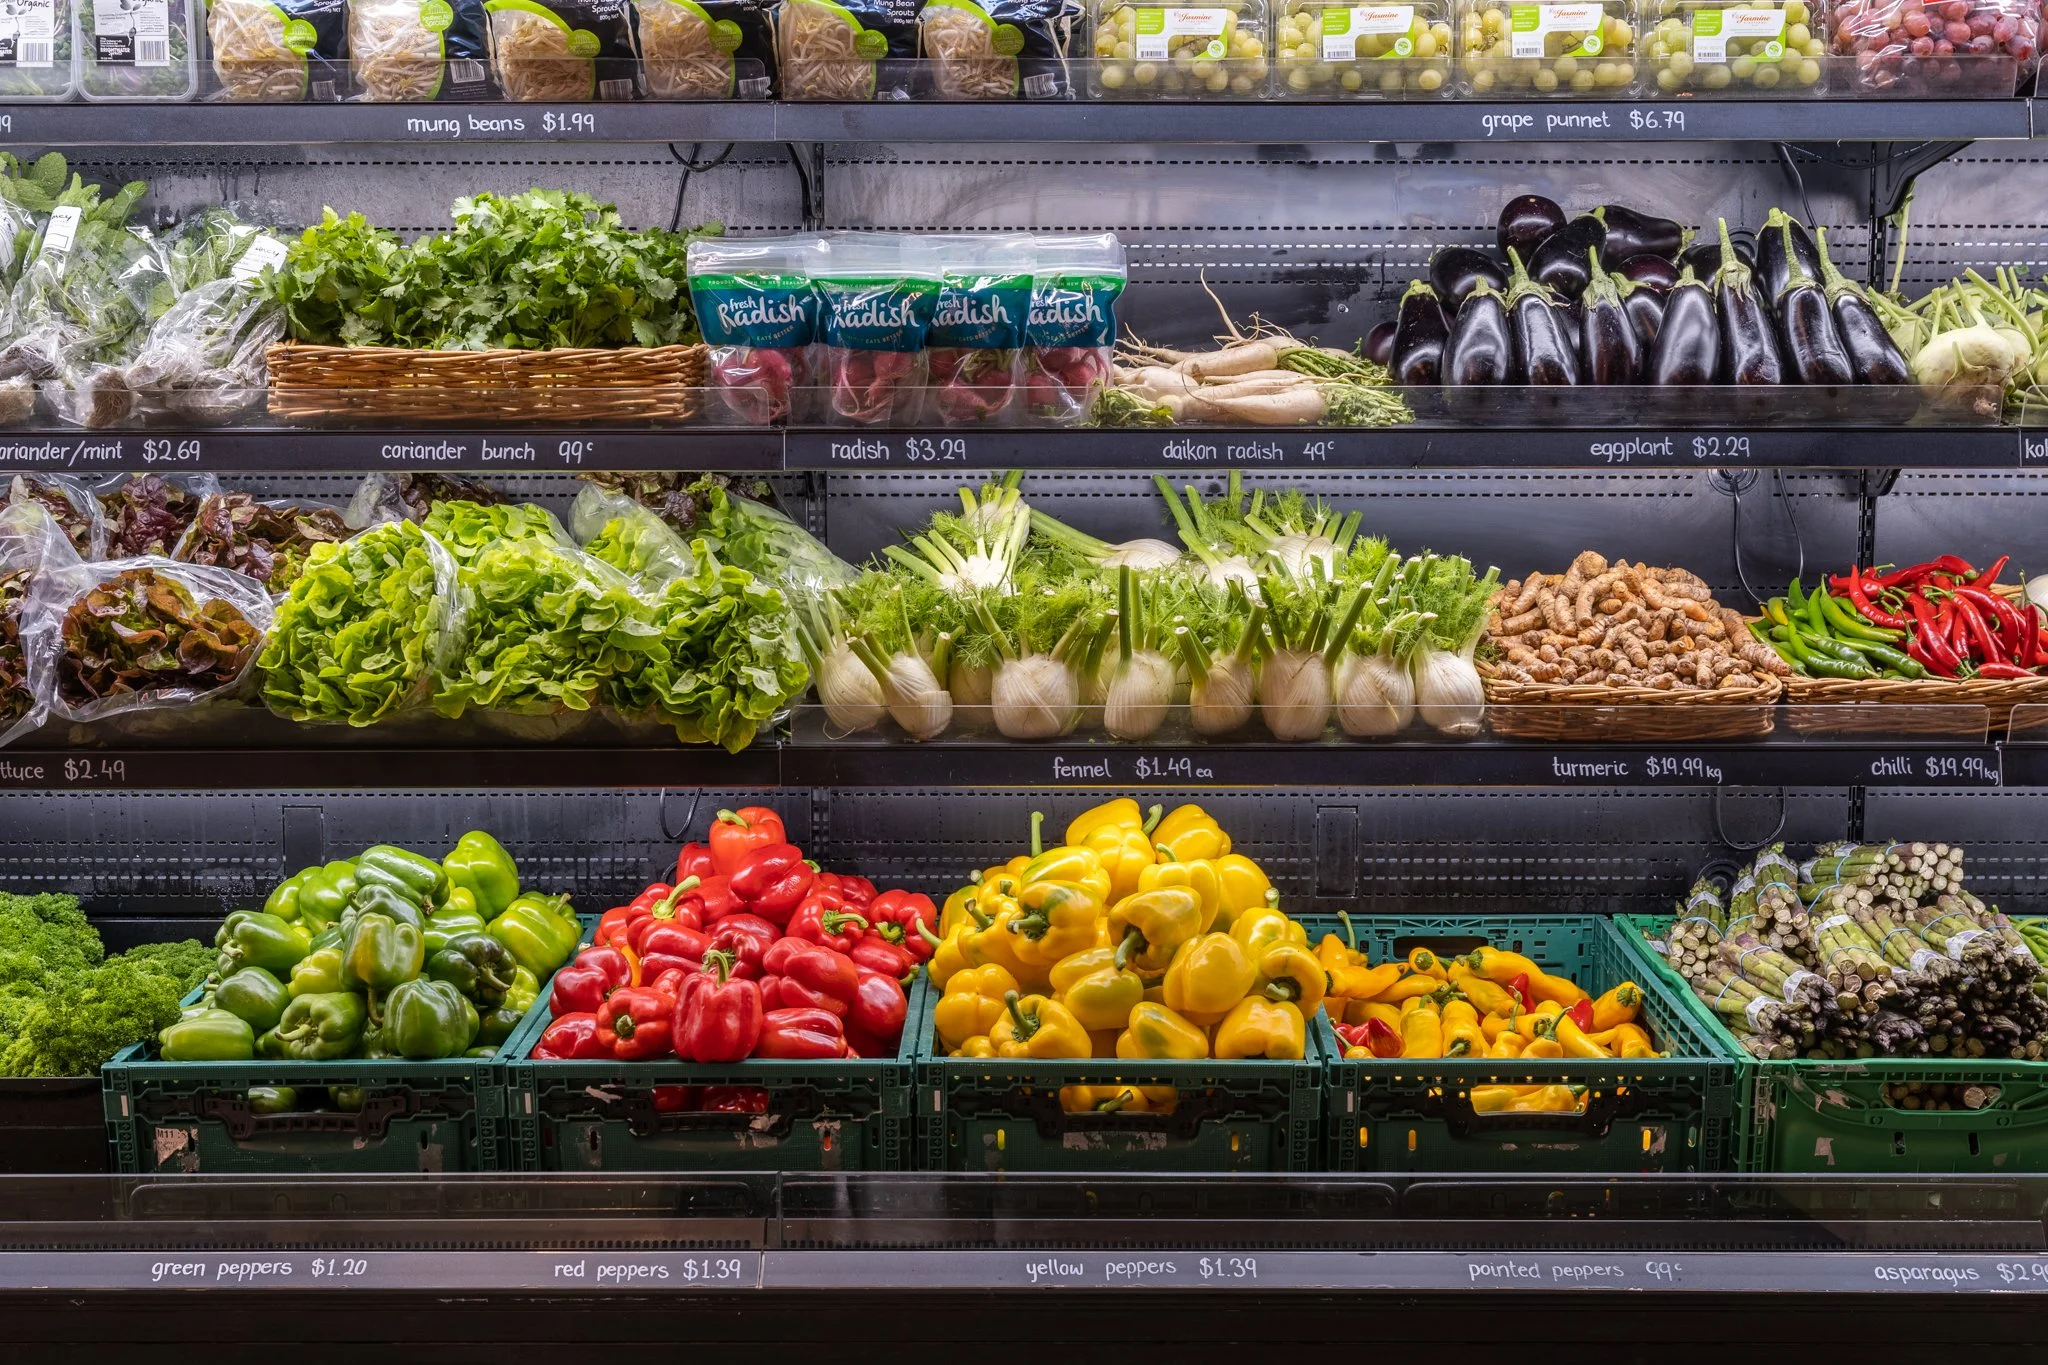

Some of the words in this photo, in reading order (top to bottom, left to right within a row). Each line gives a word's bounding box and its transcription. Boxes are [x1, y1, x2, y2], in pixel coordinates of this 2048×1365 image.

[592, 4, 618, 14] Sprouts
[886, 9, 915, 17] Sprouts
[407, 118, 460, 138] mung
[468, 114, 525, 132] beans
[542, 111, 595, 133] $1.99
[1482, 112, 1534, 136] grape
[1546, 111, 1611, 136] punnet
[1629, 110, 1686, 132] $6.79
[718, 293, 805, 328] Radish
[730, 295, 758, 312] fresh
[1027, 295, 1104, 325] adish
[142, 439, 200, 463] $2.69
[381, 440, 467, 460] coriander
[482, 440, 535, 461] bunch
[831, 438, 890, 460] radish
[905, 437, 967, 462] $3.29
[1162, 438, 1217, 460] daikon
[1227, 441, 1283, 460] radish
[1590, 436, 1674, 462] eggplant
[1692, 435, 1751, 459] $2.29
[64, 758, 125, 781] $2.49
[1053, 756, 1112, 779] fennel
[1552, 756, 1629, 777] turmeric
[1871, 756, 1913, 776] chilli
[151, 1262, 206, 1281] green
[216, 1262, 293, 1281] peppers
[311, 1257, 368, 1278] $1.20
[554, 1260, 585, 1277] red
[596, 1264, 670, 1283] peppers
[683, 1258, 741, 1281] $1.39
[1026, 1259, 1084, 1282] yellow
[1105, 1261, 1177, 1280] peppers
[1199, 1257, 1257, 1279] $1.39
[1469, 1260, 1541, 1281] pointed
[1552, 1263, 1624, 1281] peppers
[1874, 1266, 1980, 1287] asparagus
